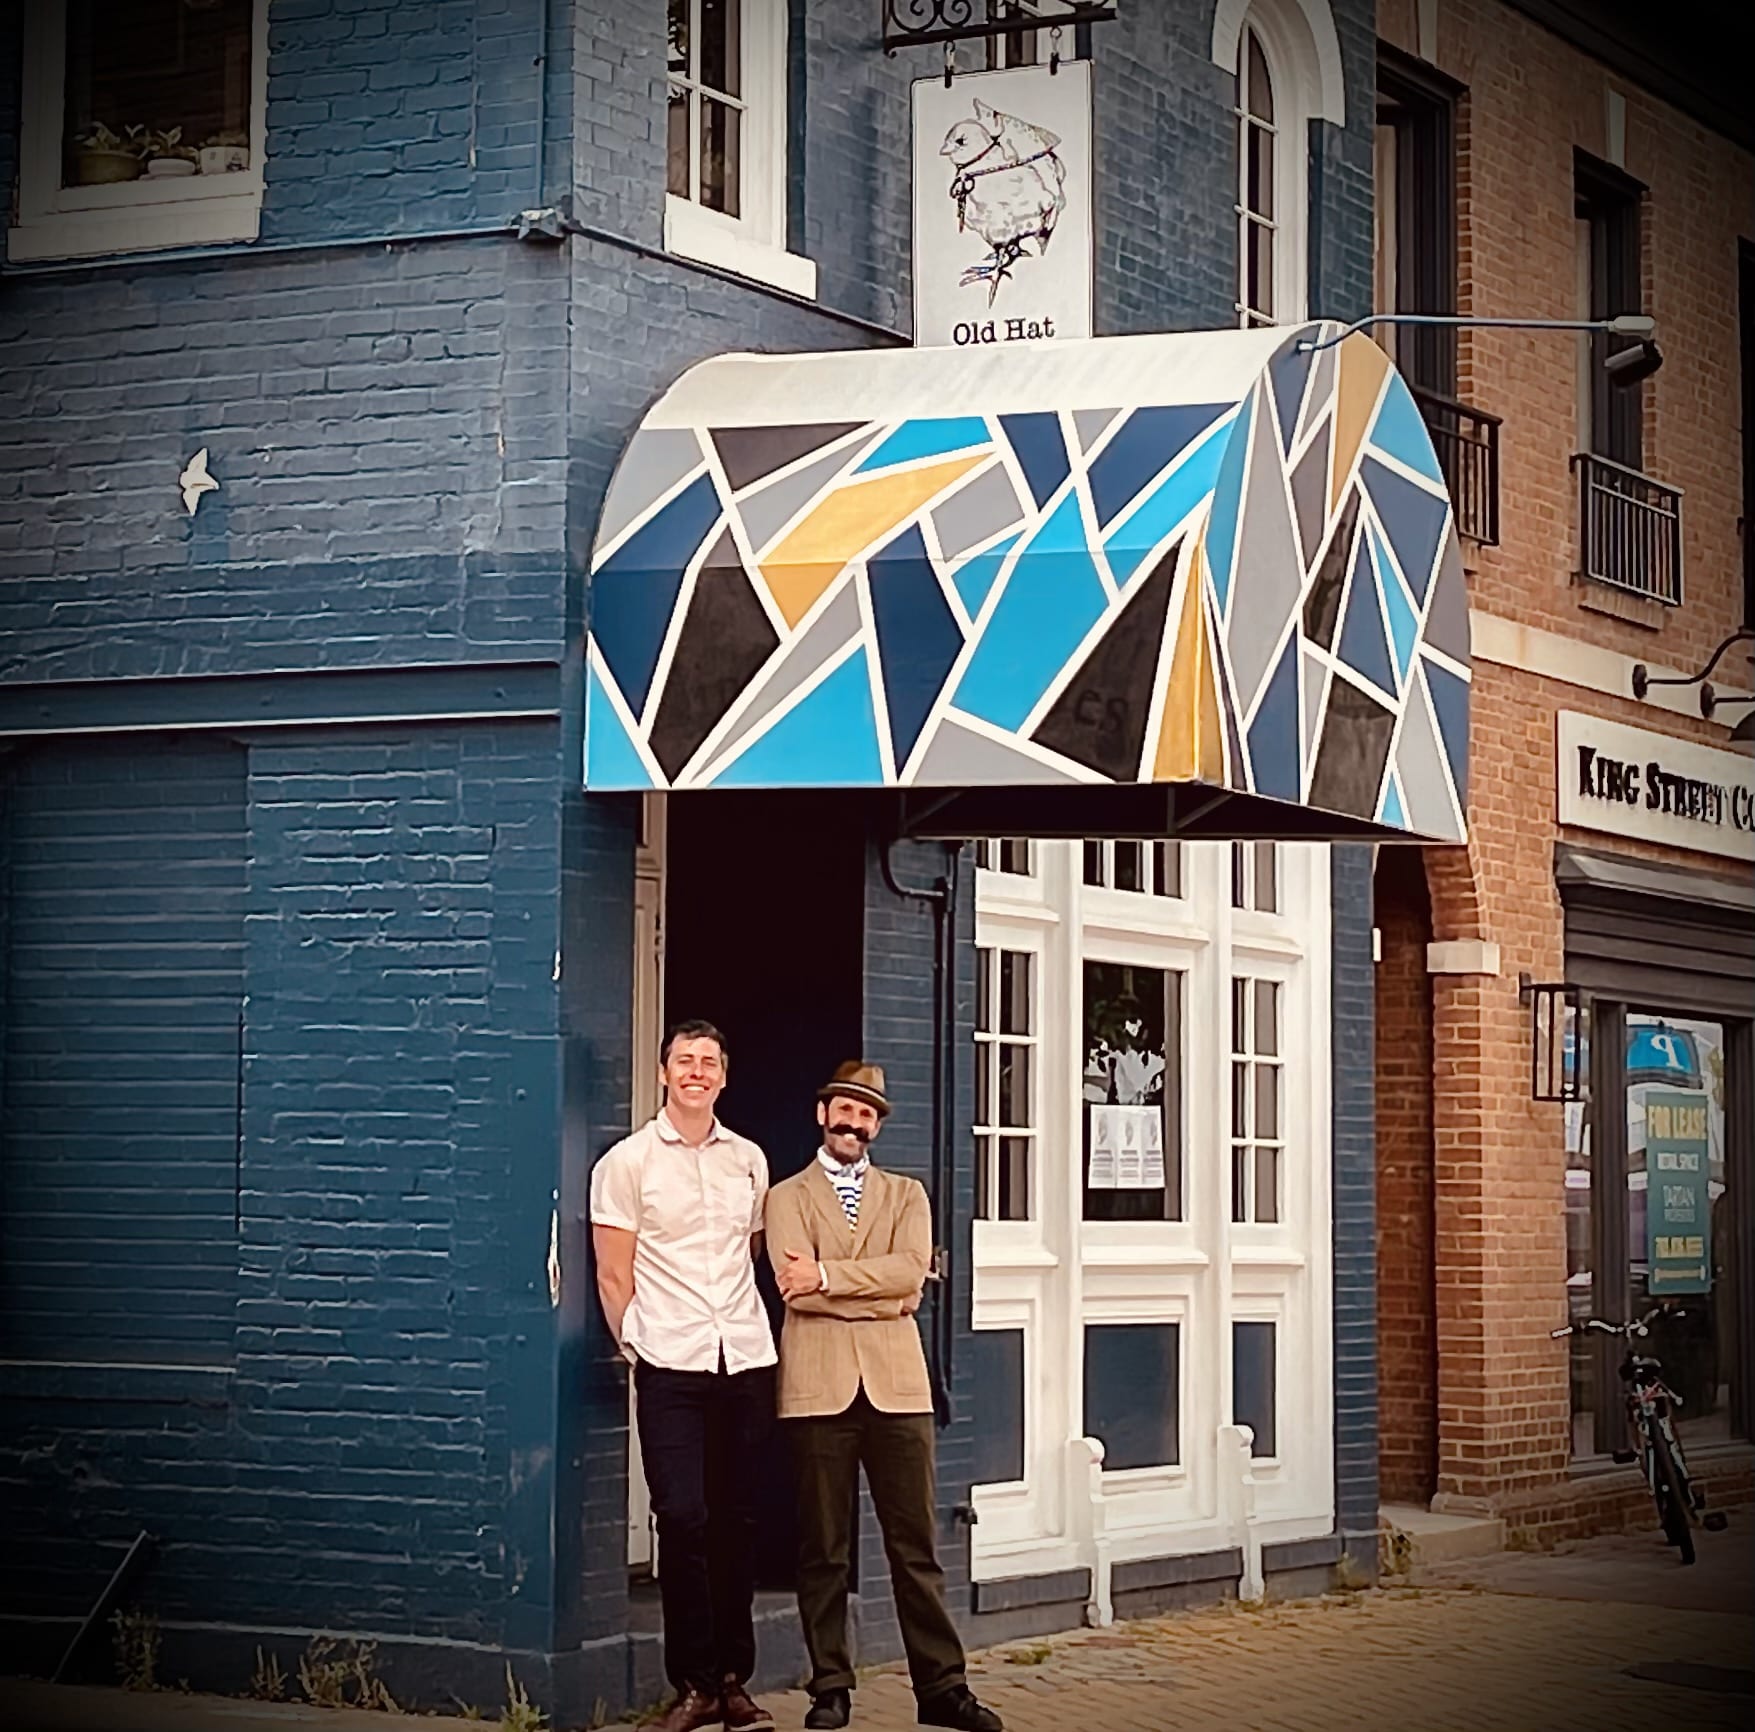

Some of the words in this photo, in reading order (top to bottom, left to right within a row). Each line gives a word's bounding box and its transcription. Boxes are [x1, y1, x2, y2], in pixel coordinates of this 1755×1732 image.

[953, 320, 997, 346] Old
[1004, 316, 1056, 341] Hat
[1577, 745, 1640, 805] KING
[1648, 1105, 1670, 1139] FOR
[1672, 1106, 1706, 1140] LEASE
